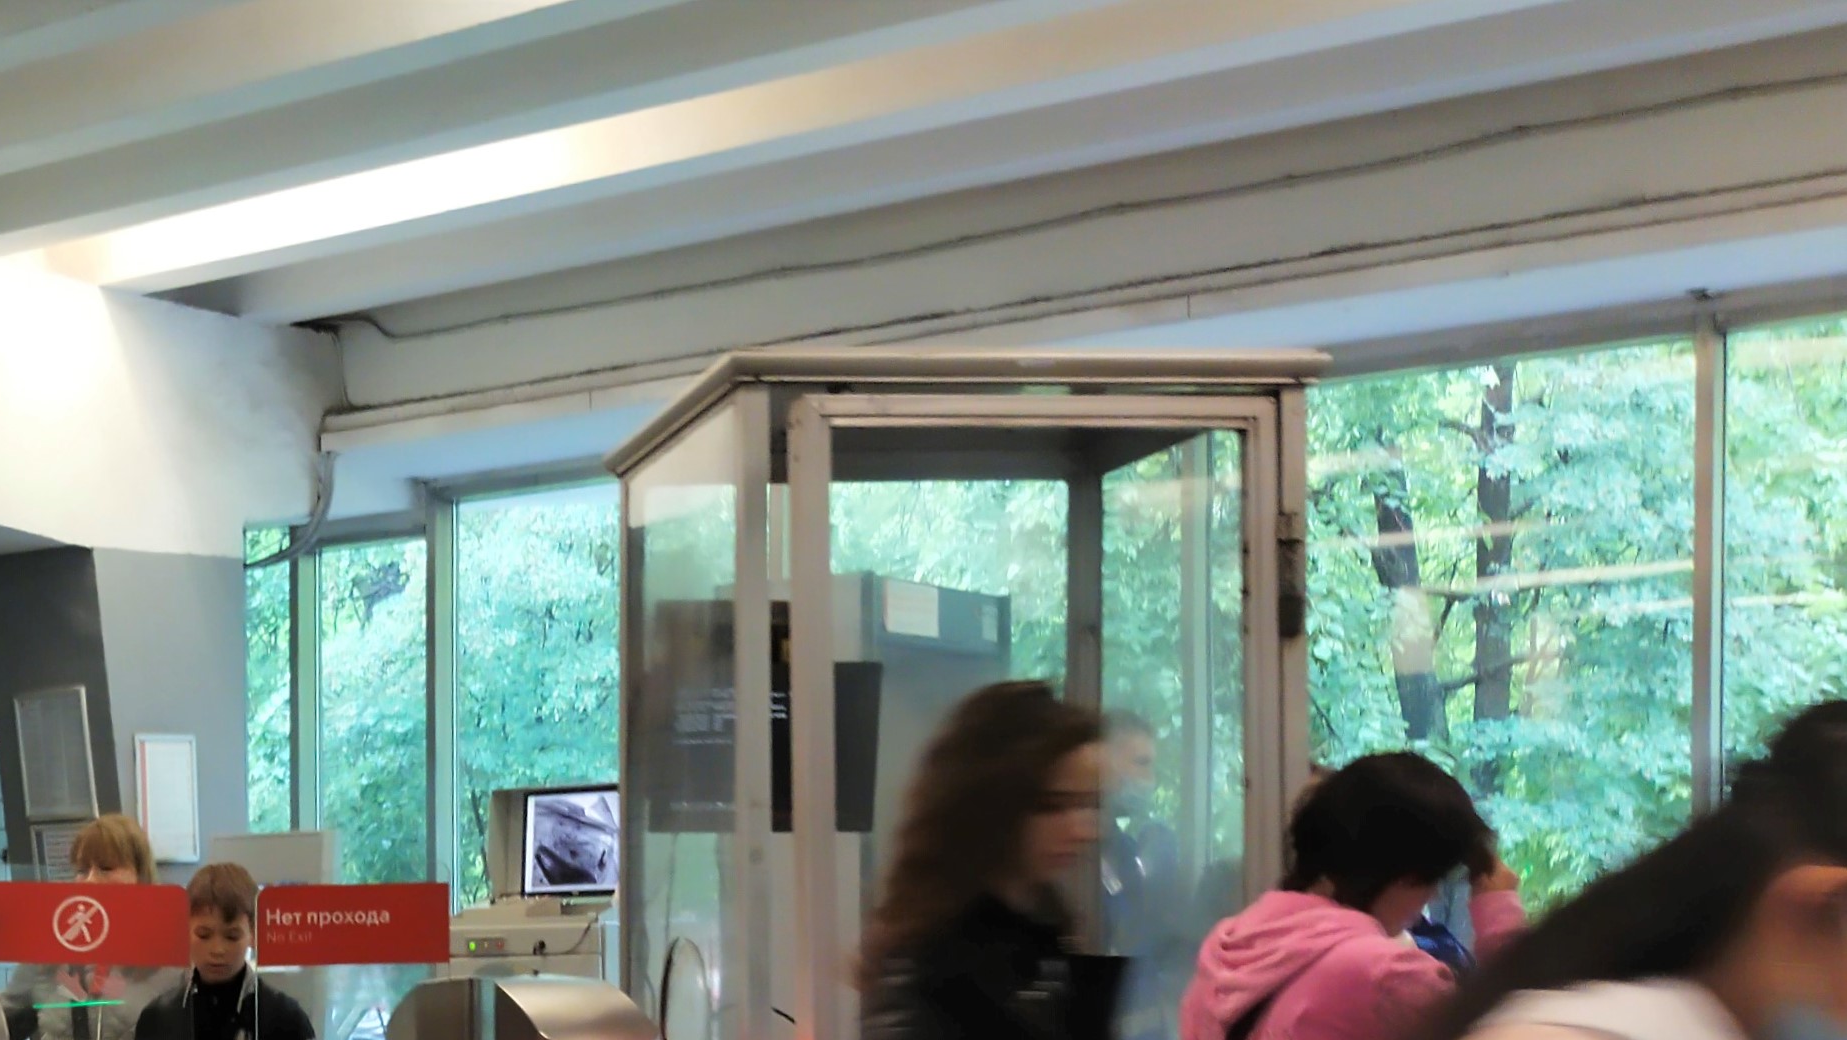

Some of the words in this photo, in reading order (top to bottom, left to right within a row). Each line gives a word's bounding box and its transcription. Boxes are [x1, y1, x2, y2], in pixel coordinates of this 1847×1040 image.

[266, 908, 301, 926] Нет
[306, 909, 390, 929] прохода
[266, 931, 285, 944] No
[289, 931, 313, 944] Exit
